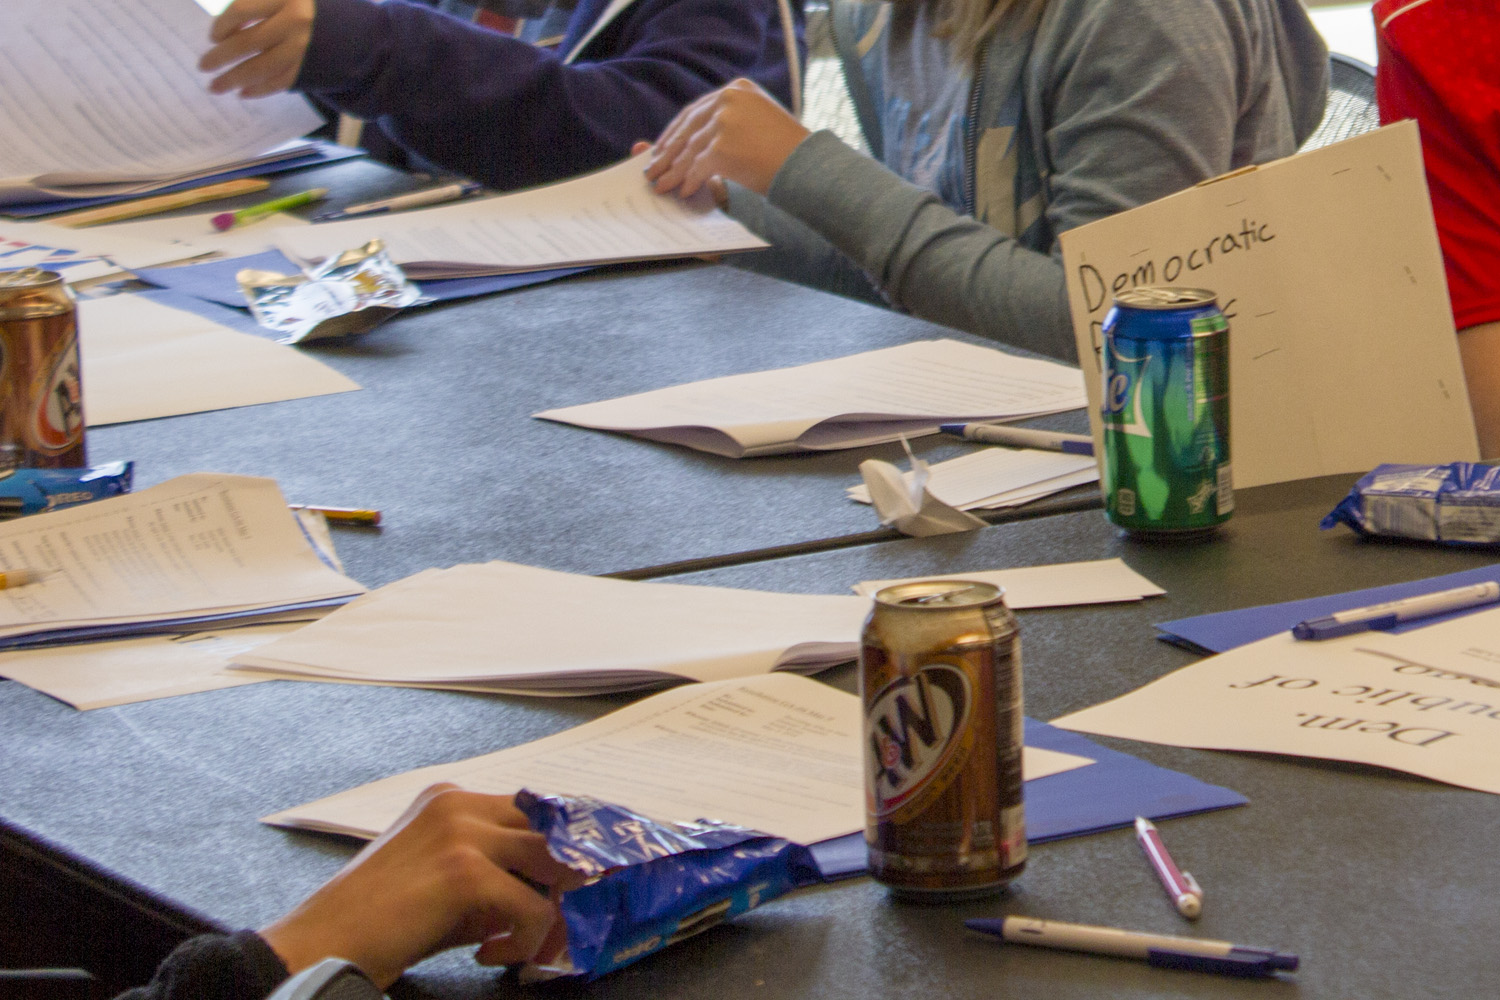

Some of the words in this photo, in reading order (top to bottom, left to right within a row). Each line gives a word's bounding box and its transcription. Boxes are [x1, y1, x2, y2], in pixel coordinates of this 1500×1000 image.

[1079, 219, 1276, 314] Democratic
[1229, 674, 1319, 690] of
[1297, 711, 1460, 748] Dem.
